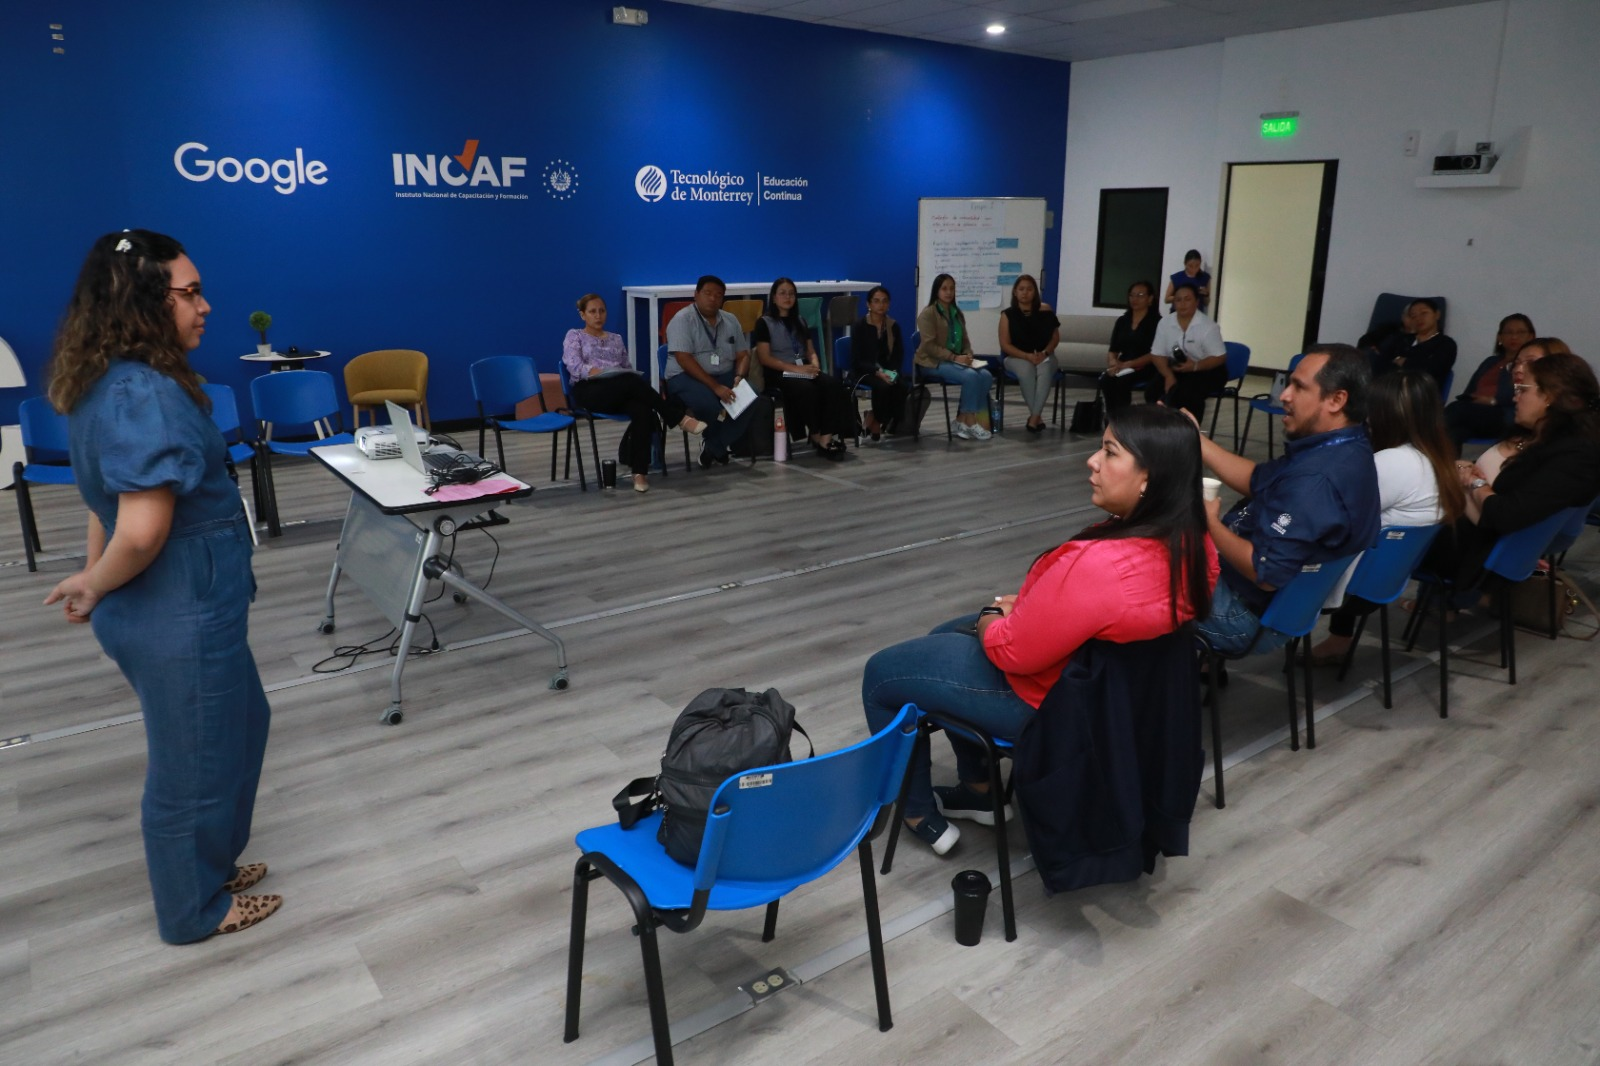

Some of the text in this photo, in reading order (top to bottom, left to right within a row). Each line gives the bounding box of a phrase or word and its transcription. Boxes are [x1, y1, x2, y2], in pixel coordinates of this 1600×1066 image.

[1263, 121, 1291, 133] SALIDA
[174, 141, 329, 195] Google
[391, 150, 528, 187] INCAF
[670, 169, 745, 190] Tecnológico
[763, 175, 808, 187] Educación
[458, 192, 494, 200] Capacitación
[671, 186, 754, 206] de Monterrey
[763, 190, 802, 201] Continua
